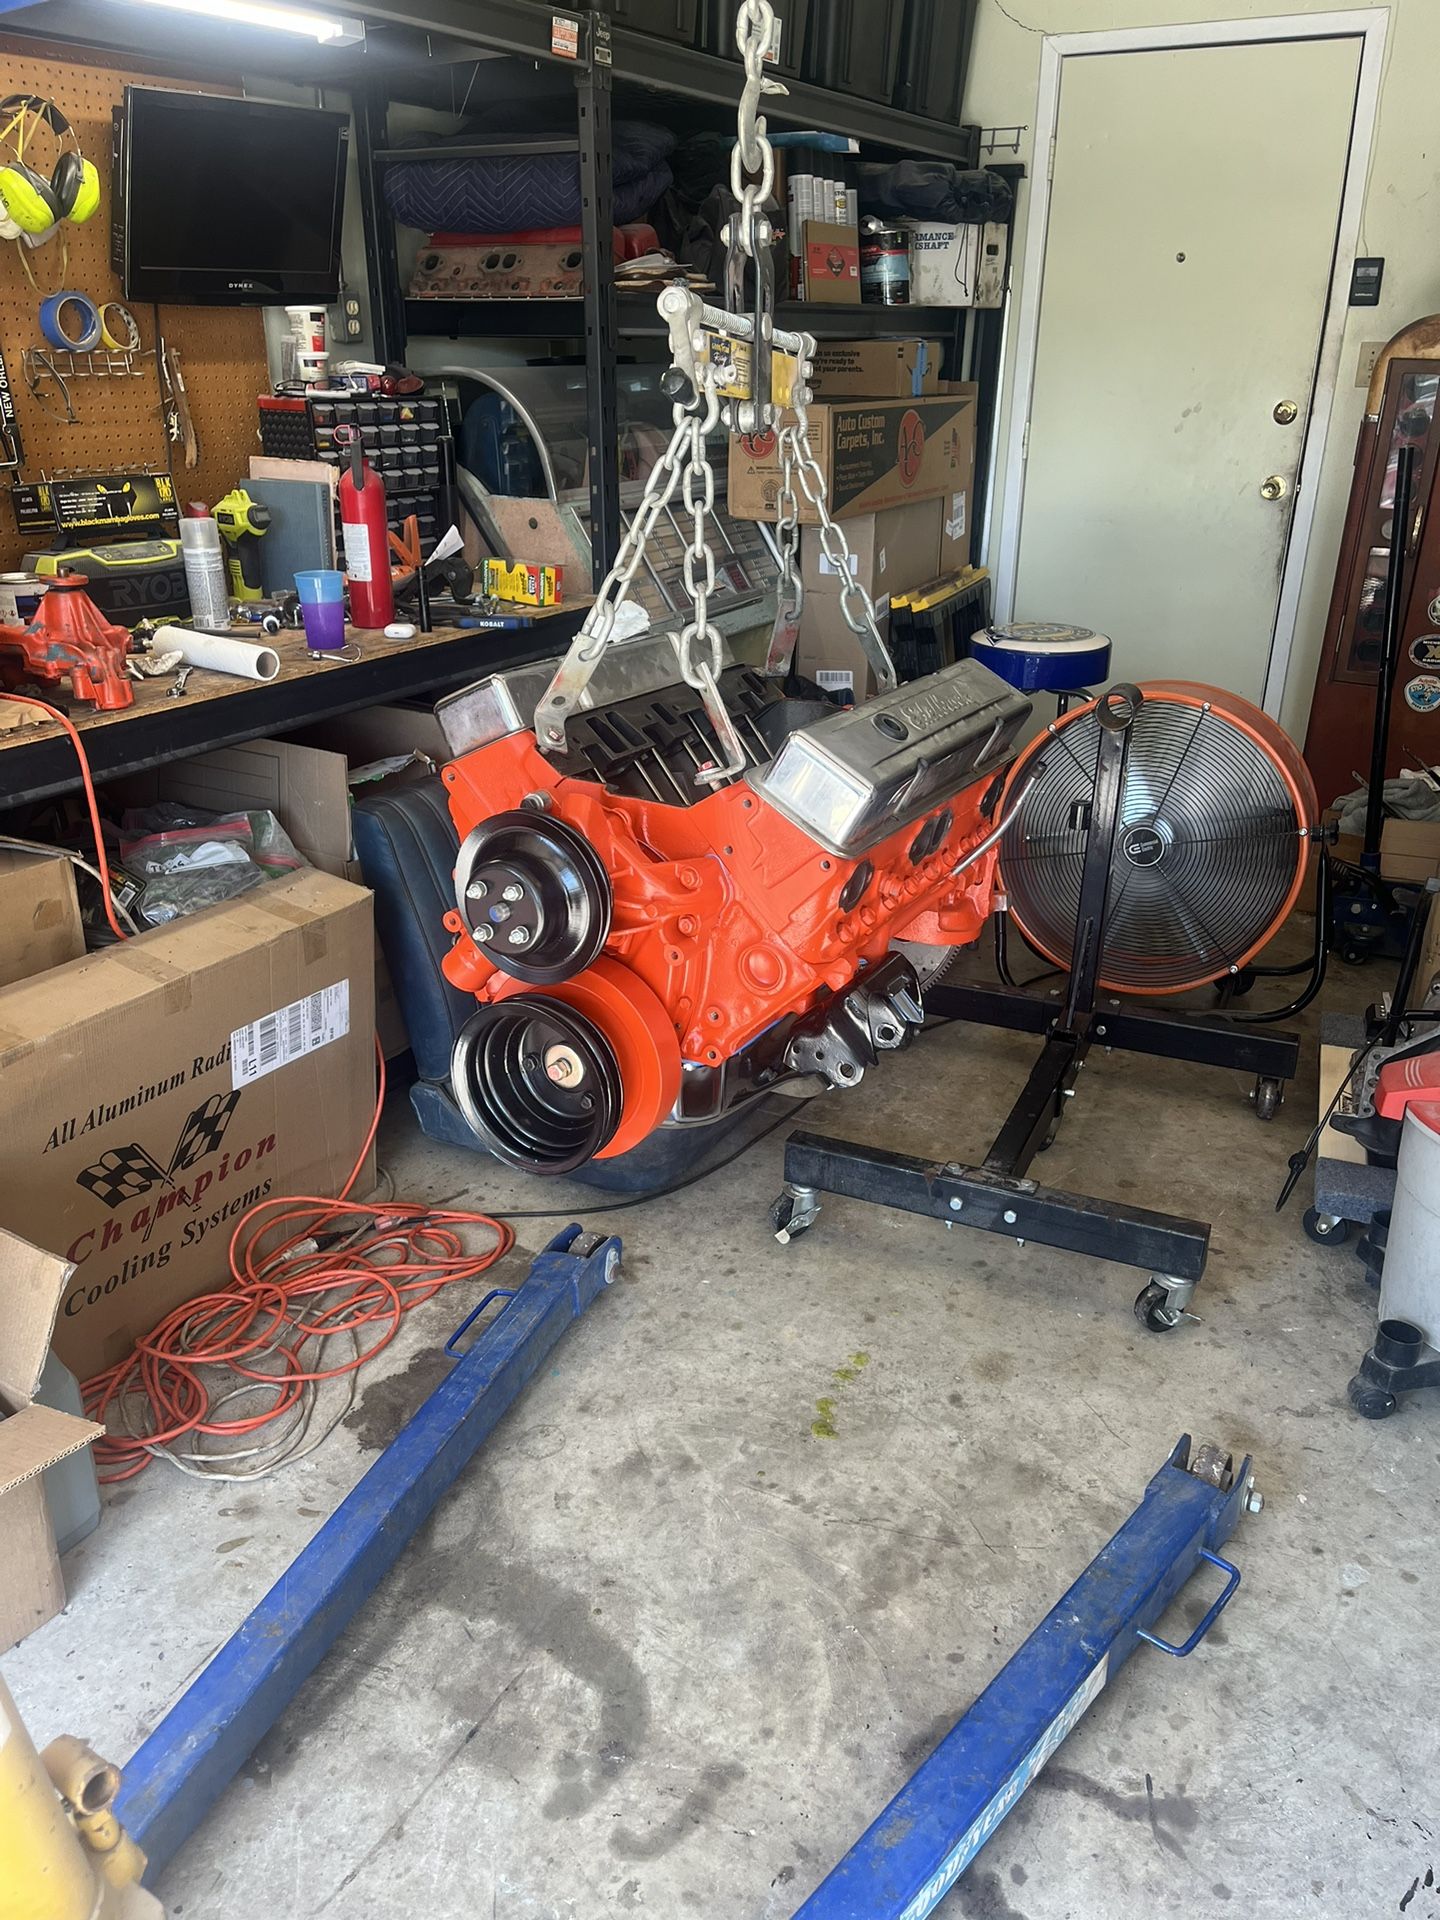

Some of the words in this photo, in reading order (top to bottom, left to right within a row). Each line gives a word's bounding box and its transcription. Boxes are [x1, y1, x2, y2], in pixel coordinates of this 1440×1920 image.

[2, 391, 14, 419] NEW
[836, 416, 857, 432] Auto
[858, 413, 886, 430] Custom
[836, 433, 870, 452] Carpets,
[871, 430, 885, 446] Inc.
[108, 572, 187, 607] RYOB
[42, 1121, 76, 1155] All
[80, 1069, 185, 1135] Aluminum
[190, 1042, 231, 1080] Radi
[66, 1132, 277, 1265] Champion
[64, 1241, 172, 1317] Cooling
[180, 1177, 272, 1250] Systems
